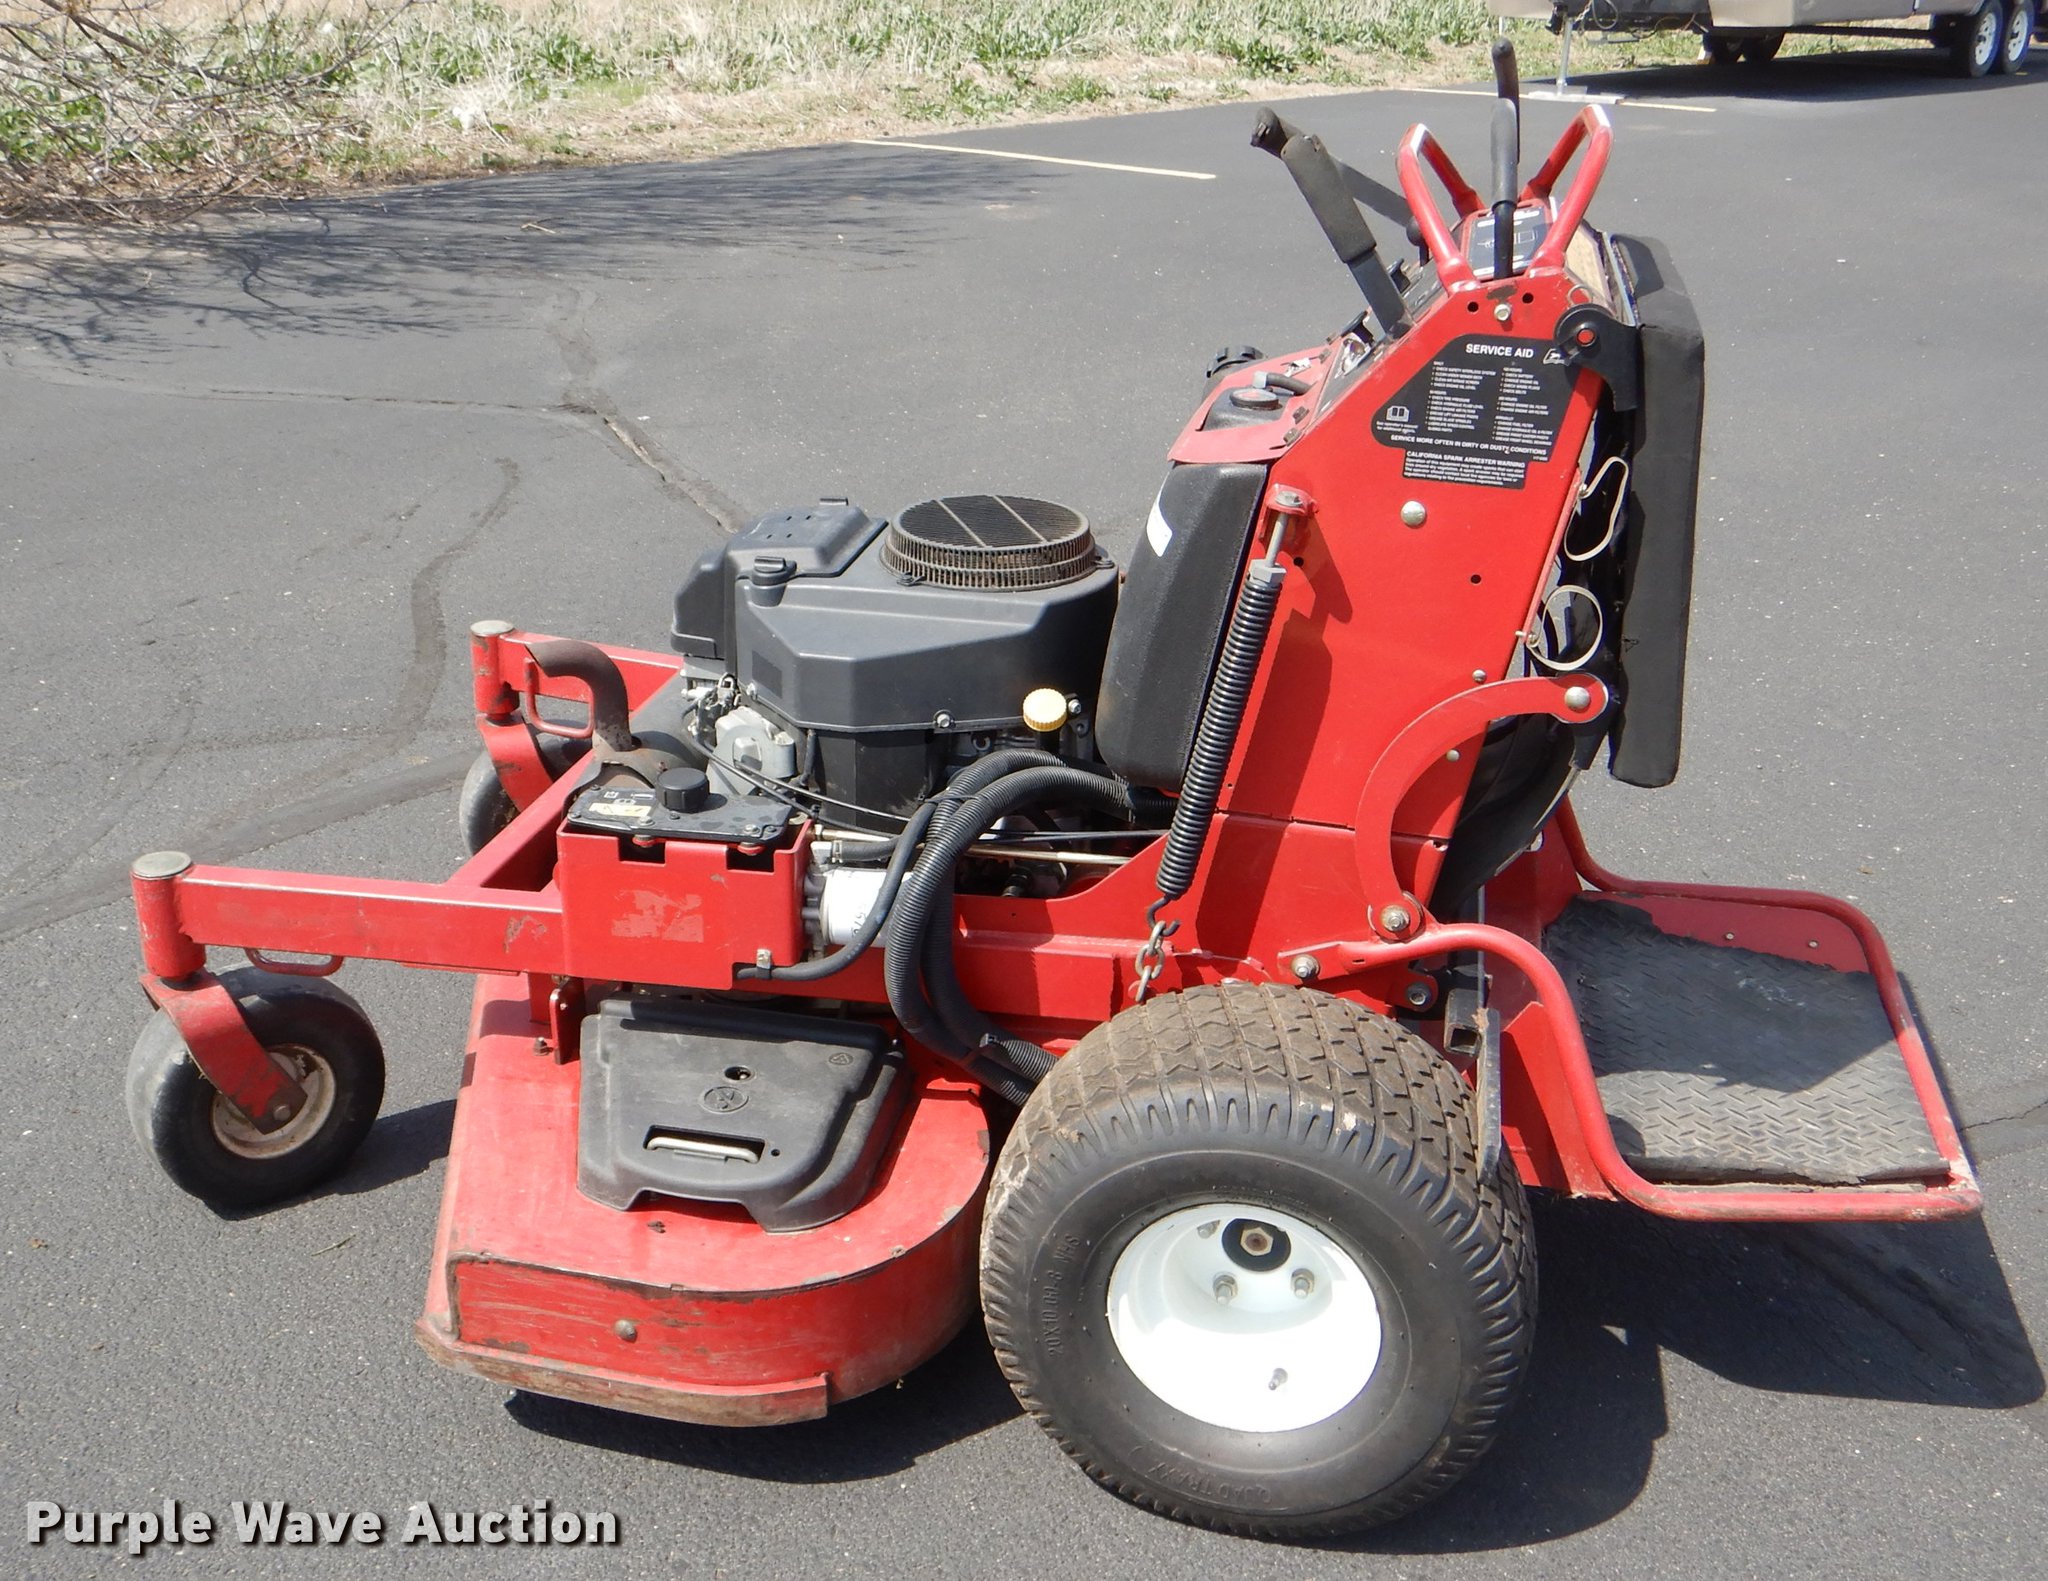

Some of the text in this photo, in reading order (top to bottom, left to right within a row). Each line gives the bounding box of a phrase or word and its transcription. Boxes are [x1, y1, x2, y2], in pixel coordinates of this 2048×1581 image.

[1465, 343, 1534, 358] SERVICE AID
[1390, 434, 1415, 443] SERVICE
[1416, 436, 1434, 444] MORE
[1434, 438, 1454, 446] OFTEN
[1510, 445, 1546, 455] CONDITIONS
[1406, 450, 1526, 468] CALIFORNIA SPARK ARRESTER WARNING
